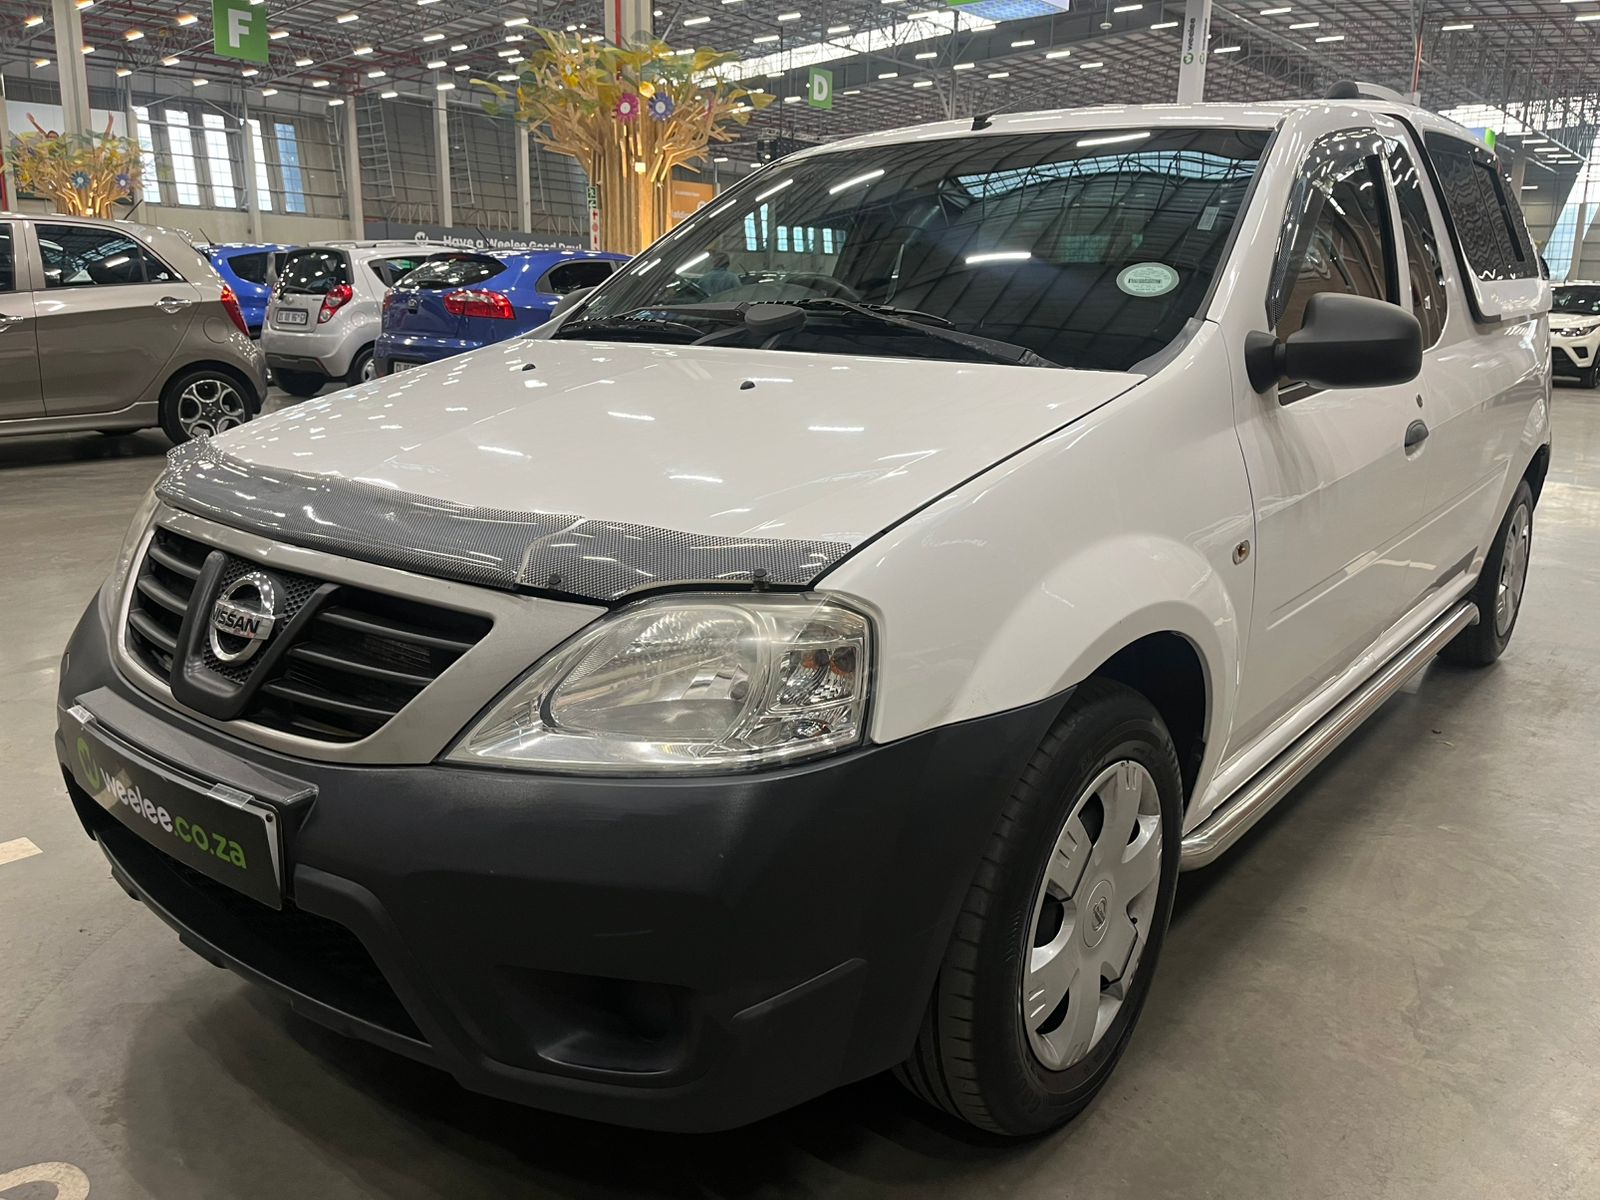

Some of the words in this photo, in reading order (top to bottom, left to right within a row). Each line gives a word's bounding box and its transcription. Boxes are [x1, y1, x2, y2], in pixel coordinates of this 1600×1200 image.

[228, 8, 252, 48] F
[813, 74, 828, 101] D
[443, 235, 474, 247] Have
[476, 239, 484, 248] a
[212, 606, 260, 634] NISSAN
[99, 767, 247, 869] weelee.co.za
